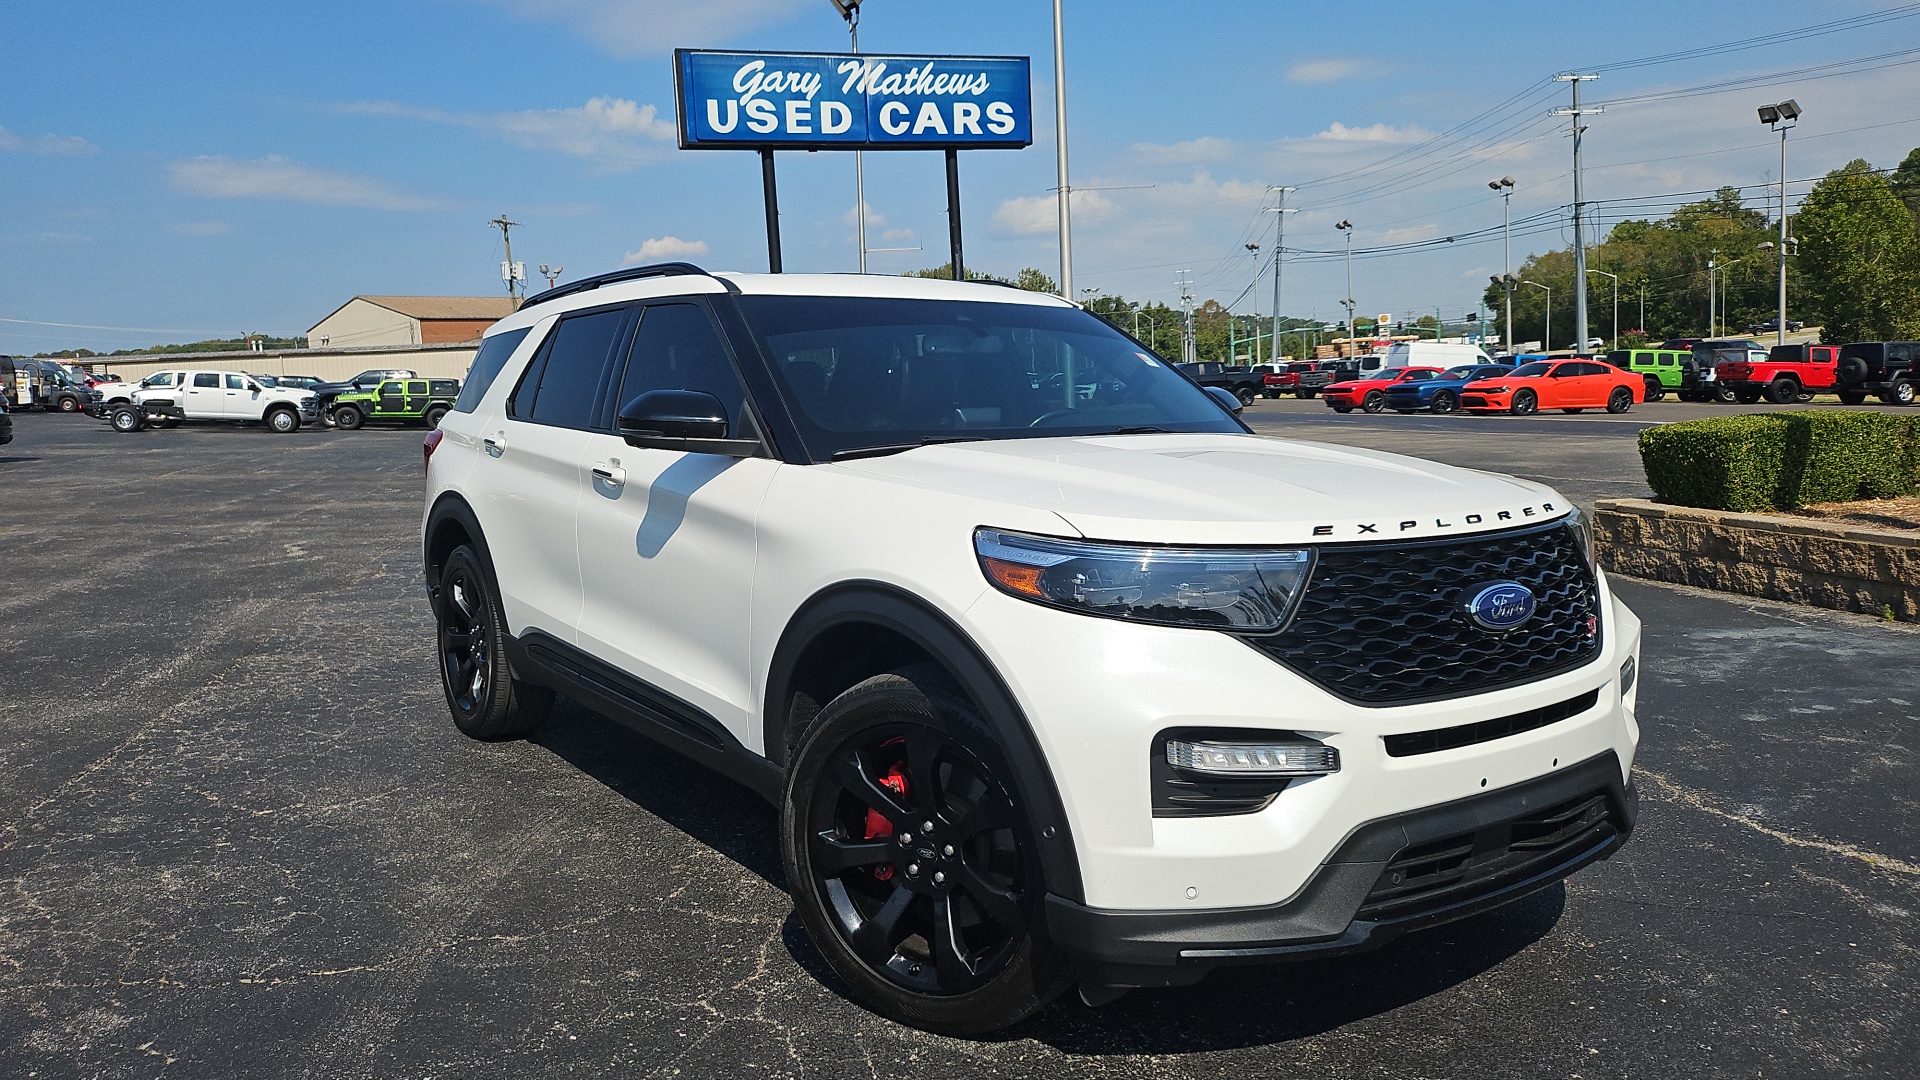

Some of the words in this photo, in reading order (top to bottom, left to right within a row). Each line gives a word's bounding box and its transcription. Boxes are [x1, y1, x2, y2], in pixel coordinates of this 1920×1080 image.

[732, 60, 823, 106] Gary
[837, 61, 991, 96] Mathews
[706, 99, 853, 134] USED
[879, 101, 1016, 135] CARS
[1312, 502, 1555, 537] EXPLORER
[1491, 593, 1526, 619] Ford
